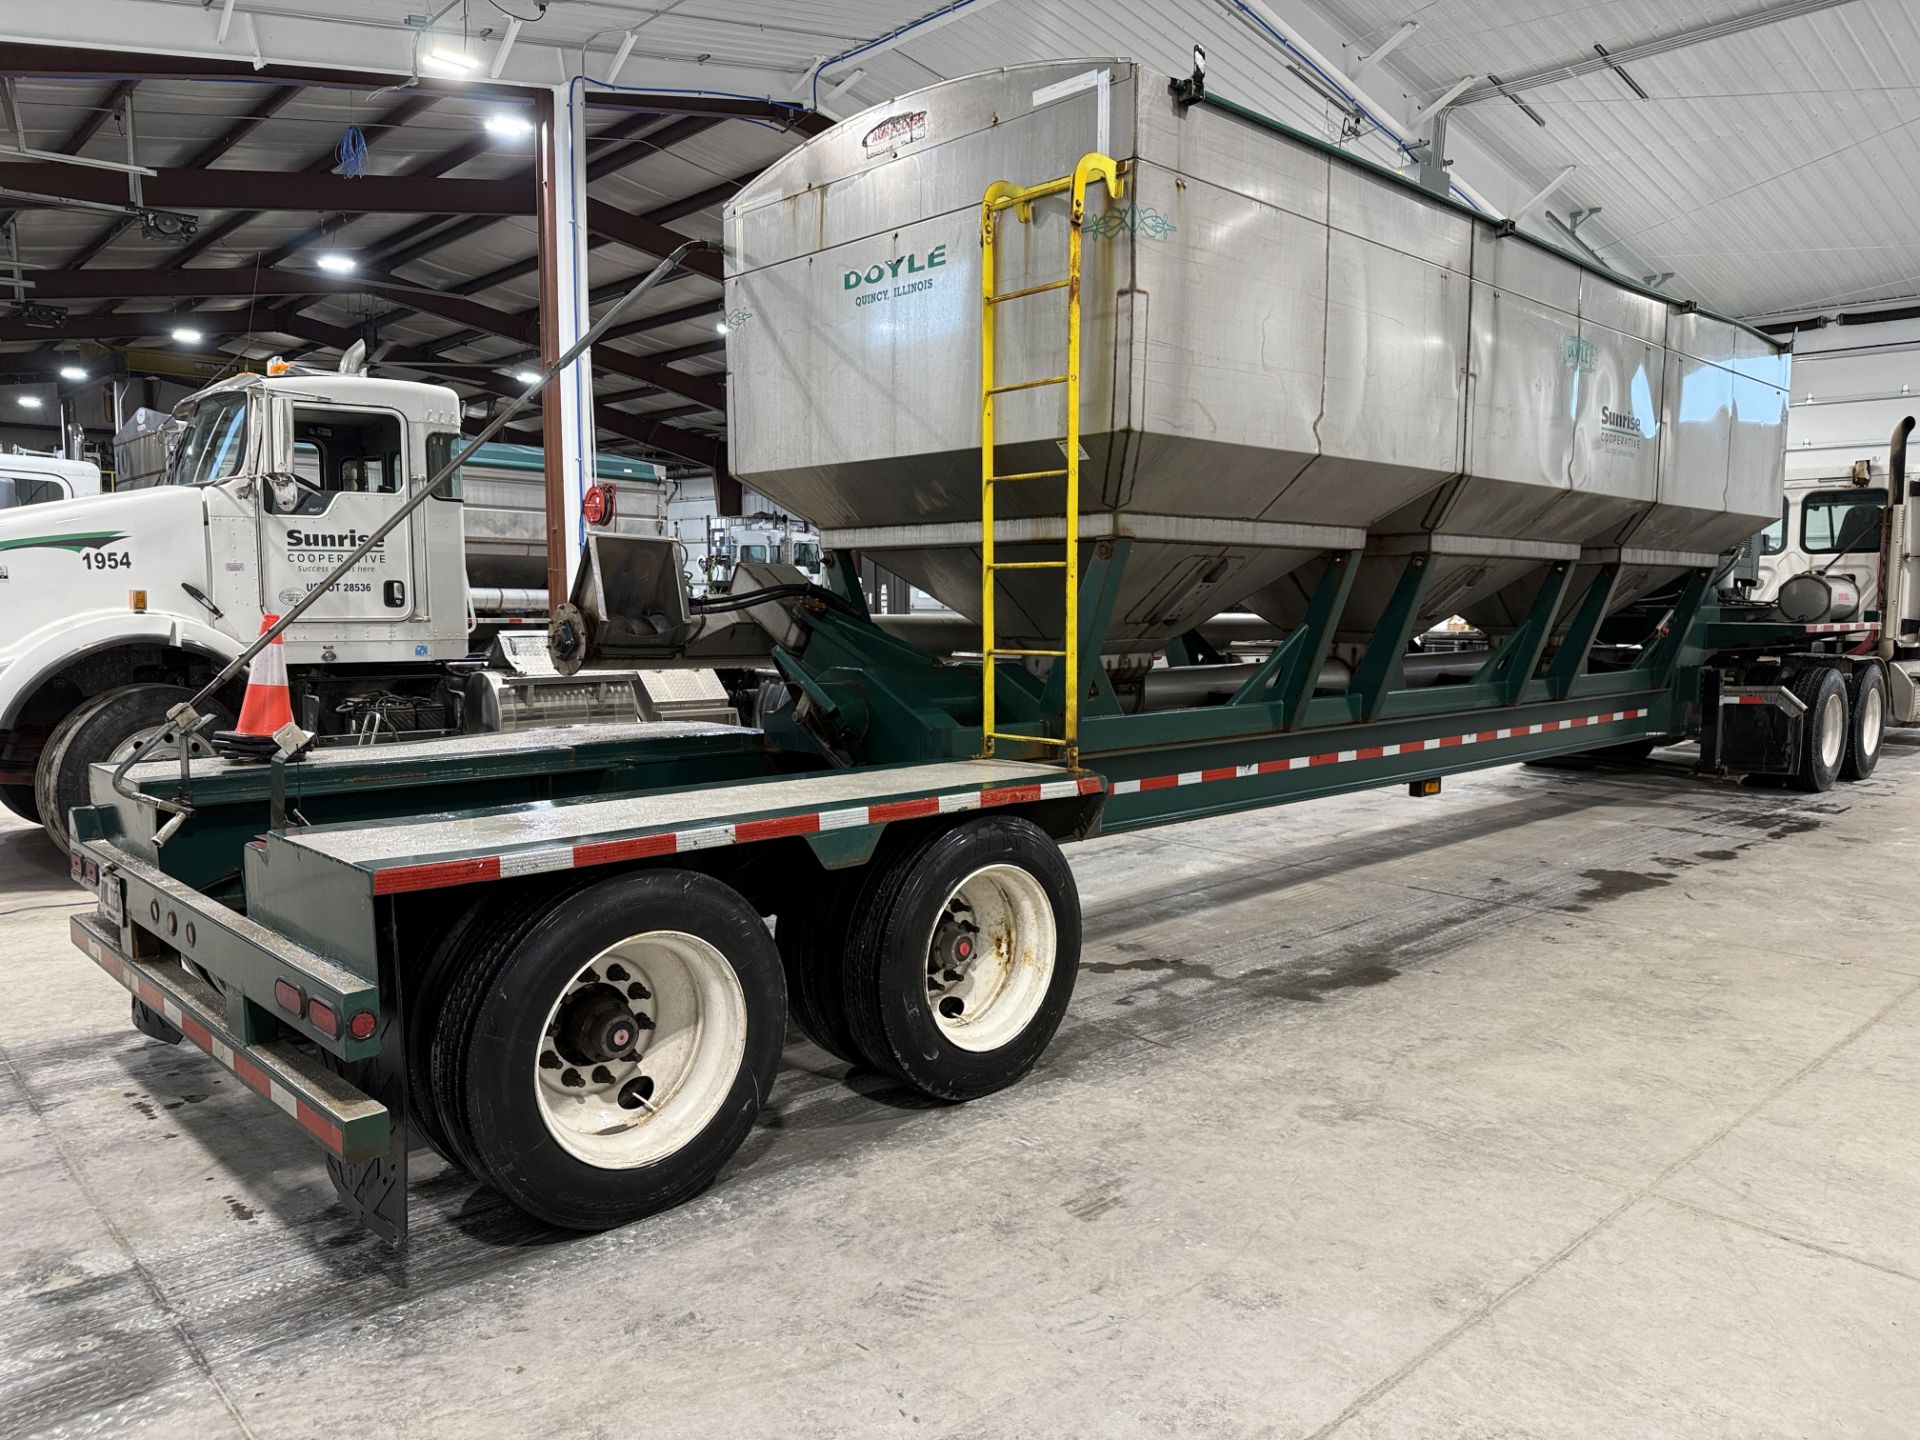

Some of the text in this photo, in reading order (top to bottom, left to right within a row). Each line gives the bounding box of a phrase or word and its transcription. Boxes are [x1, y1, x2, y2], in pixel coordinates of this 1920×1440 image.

[844, 244, 947, 291] DOYLE
[855, 278, 933, 307] QUINCY, ILLINOIS
[1601, 405, 1641, 432] Sunrise
[82, 551, 132, 570] 1954
[287, 553, 387, 564] COOPERIVE
[297, 565, 329, 573] Success
[306, 583, 372, 592] UOT 28536
